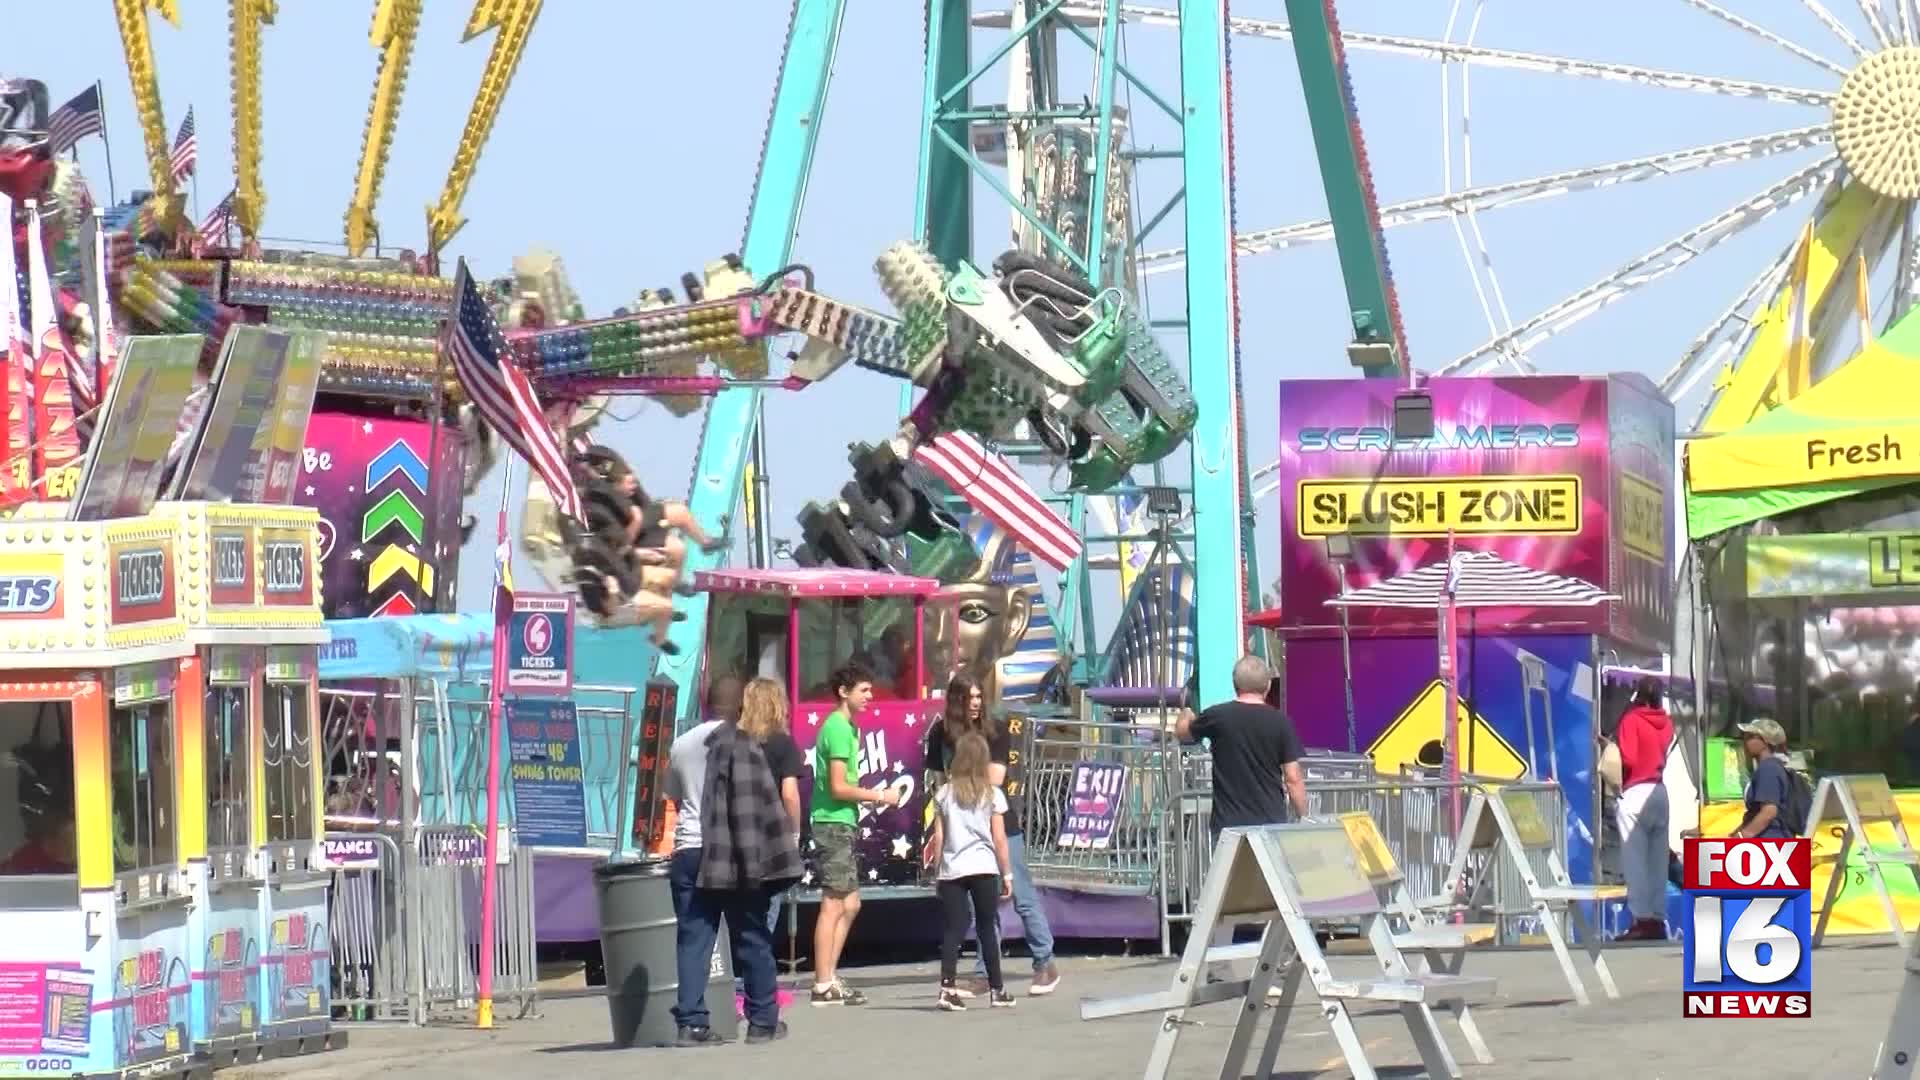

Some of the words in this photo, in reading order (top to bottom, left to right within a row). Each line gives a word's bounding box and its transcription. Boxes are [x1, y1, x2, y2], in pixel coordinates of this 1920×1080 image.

[302, 447, 333, 473] Be
[1807, 433, 1901, 470] Fresh
[1312, 491, 1446, 525] SLUSH
[1459, 488, 1567, 523] ZONE
[119, 550, 164, 602] TICKETS
[265, 544, 304, 590] TICKETS
[0, 579, 51, 607] ETS
[521, 656, 555, 668] TICKETS
[1076, 767, 1122, 794] EXIT
